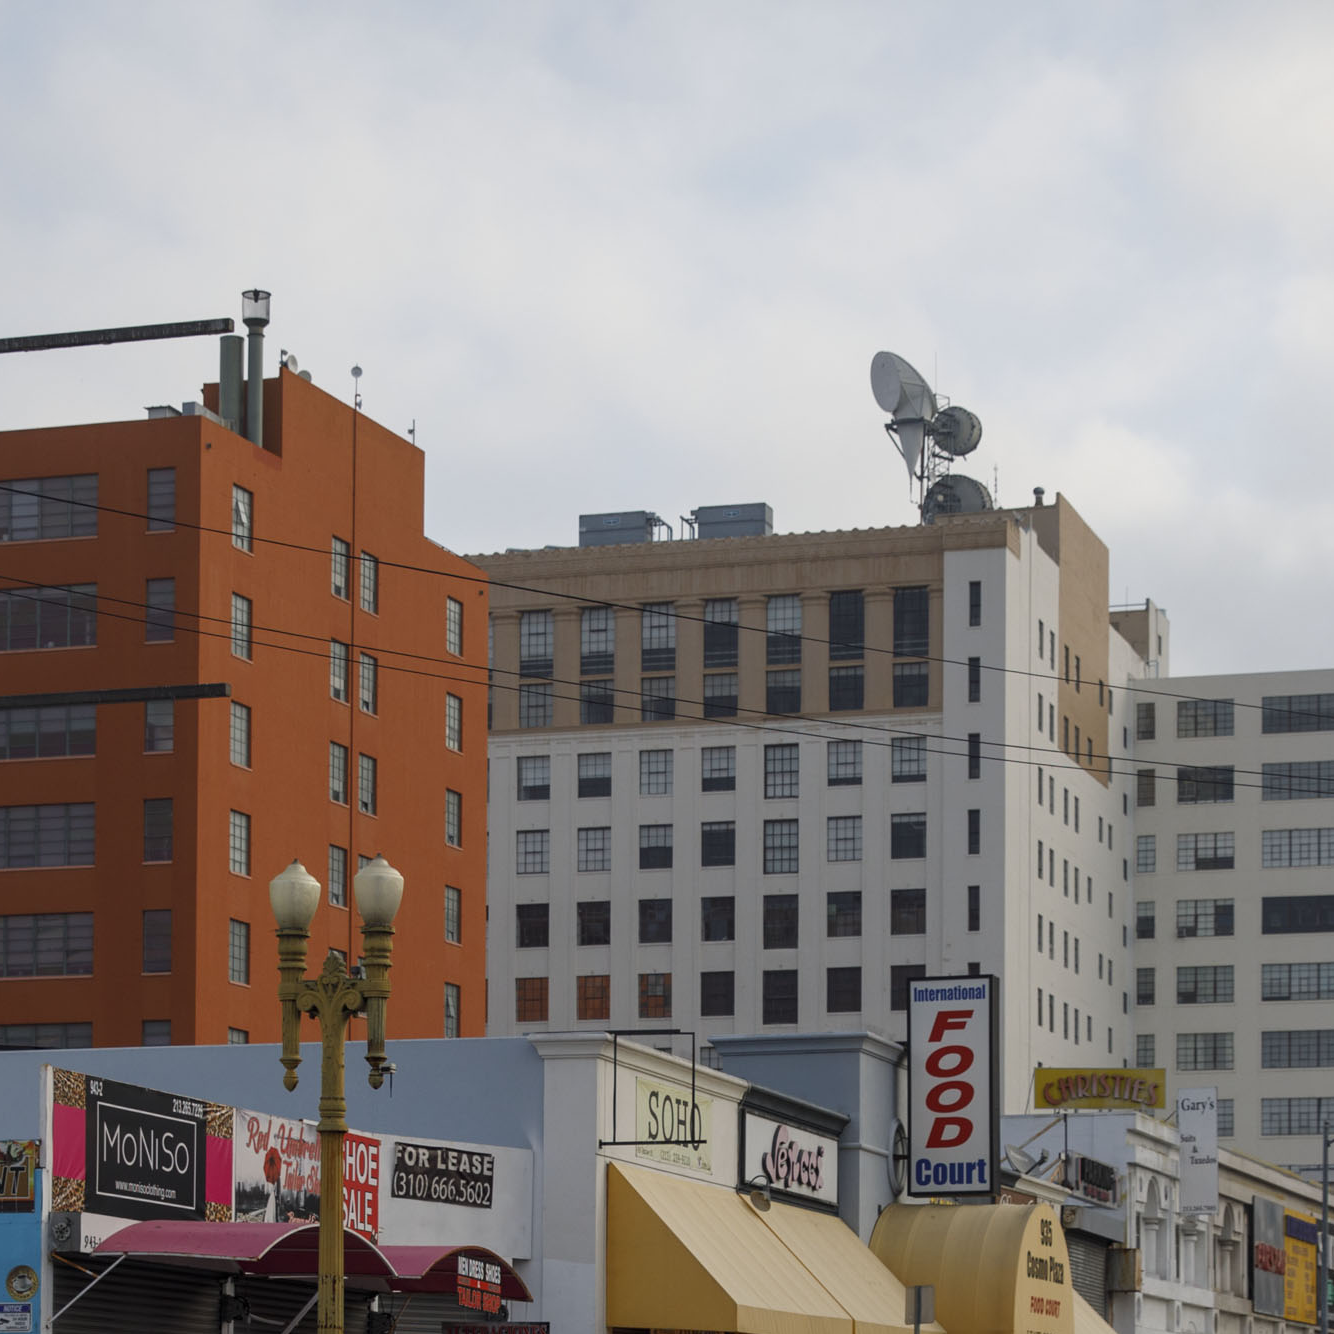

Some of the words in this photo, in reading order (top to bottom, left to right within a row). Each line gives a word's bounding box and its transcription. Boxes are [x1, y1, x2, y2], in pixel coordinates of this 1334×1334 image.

[913, 984, 986, 1002] International
[925, 1009, 974, 1148] FOOD
[1043, 1073, 1158, 1106] CHRISTIES
[648, 1091, 702, 1151] SOHO
[1181, 1097, 1215, 1115] Gary's
[246, 1116, 272, 1154] Red
[343, 1140, 378, 1187] HOE
[395, 1144, 430, 1168] FOR
[436, 1149, 493, 1176] LEASE
[915, 1158, 987, 1186] Court
[393, 1171, 429, 1198] (310)
[431, 1176, 491, 1206] 666.5602
[1040, 1218, 1053, 1246] 935
[1027, 1251, 1048, 1281] Cosmo
[1050, 1256, 1064, 1284] Plaza
[1030, 1296, 1044, 1315] FOOD
[1045, 1300, 1061, 1319] COURT
